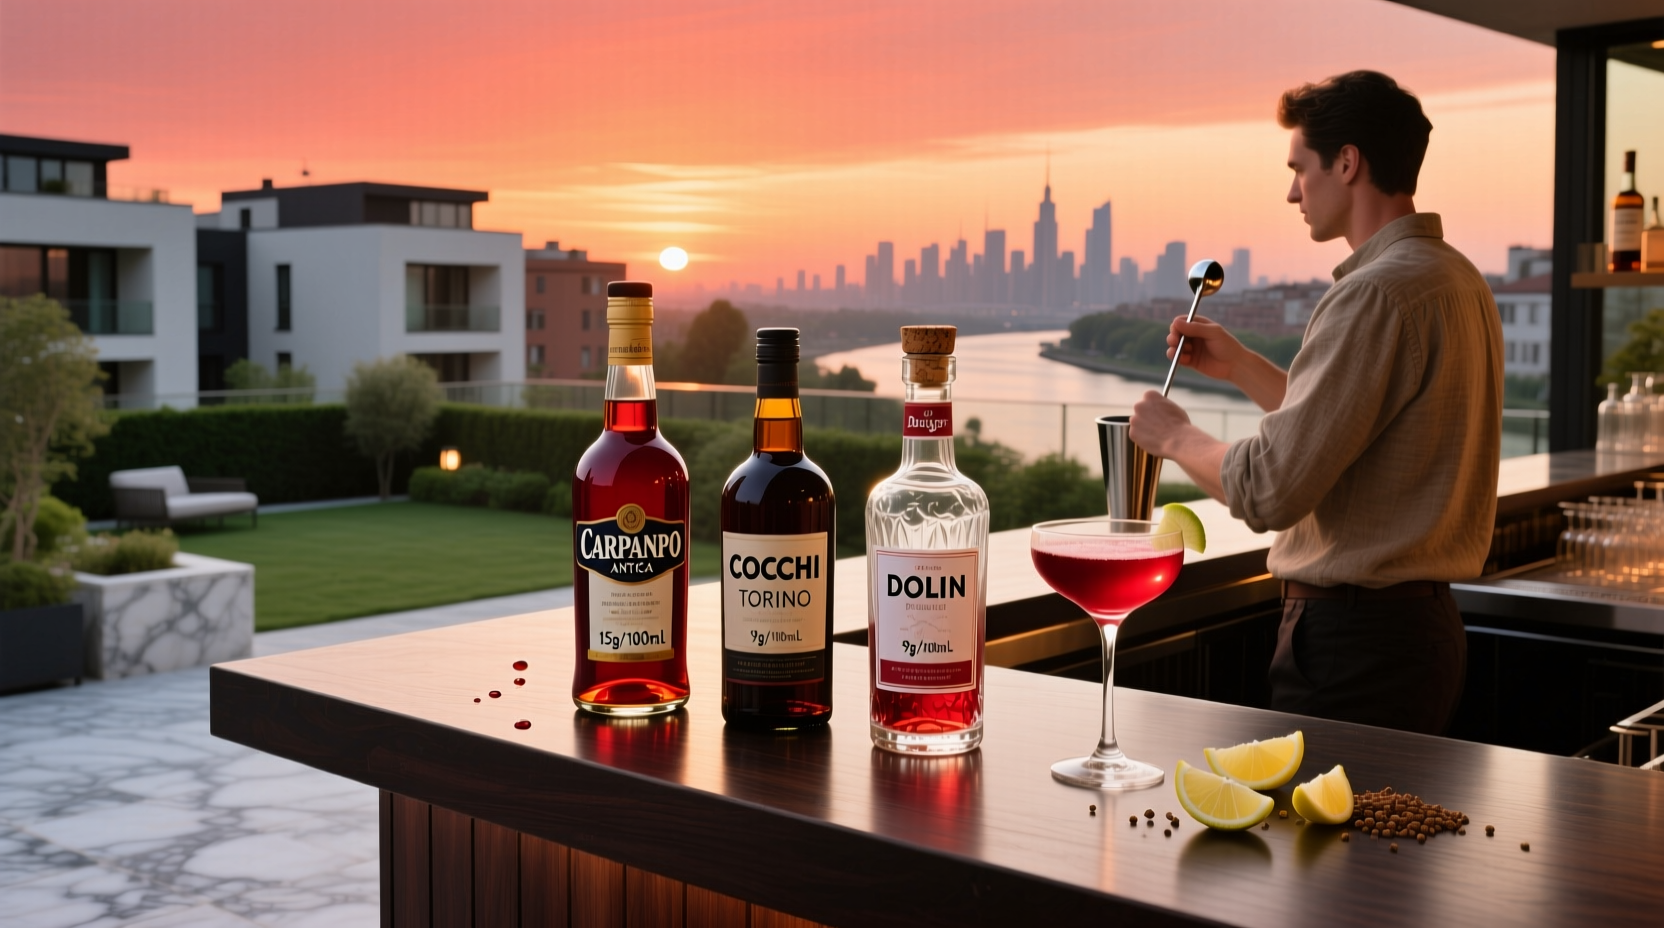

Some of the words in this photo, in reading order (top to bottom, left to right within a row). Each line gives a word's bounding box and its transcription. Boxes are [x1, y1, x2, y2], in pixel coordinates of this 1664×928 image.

[580, 528, 682, 560] CARPANPO
[729, 553, 820, 581] COCCHI
[738, 588, 812, 609] TORINO
[887, 573, 966, 599] DOLIN
